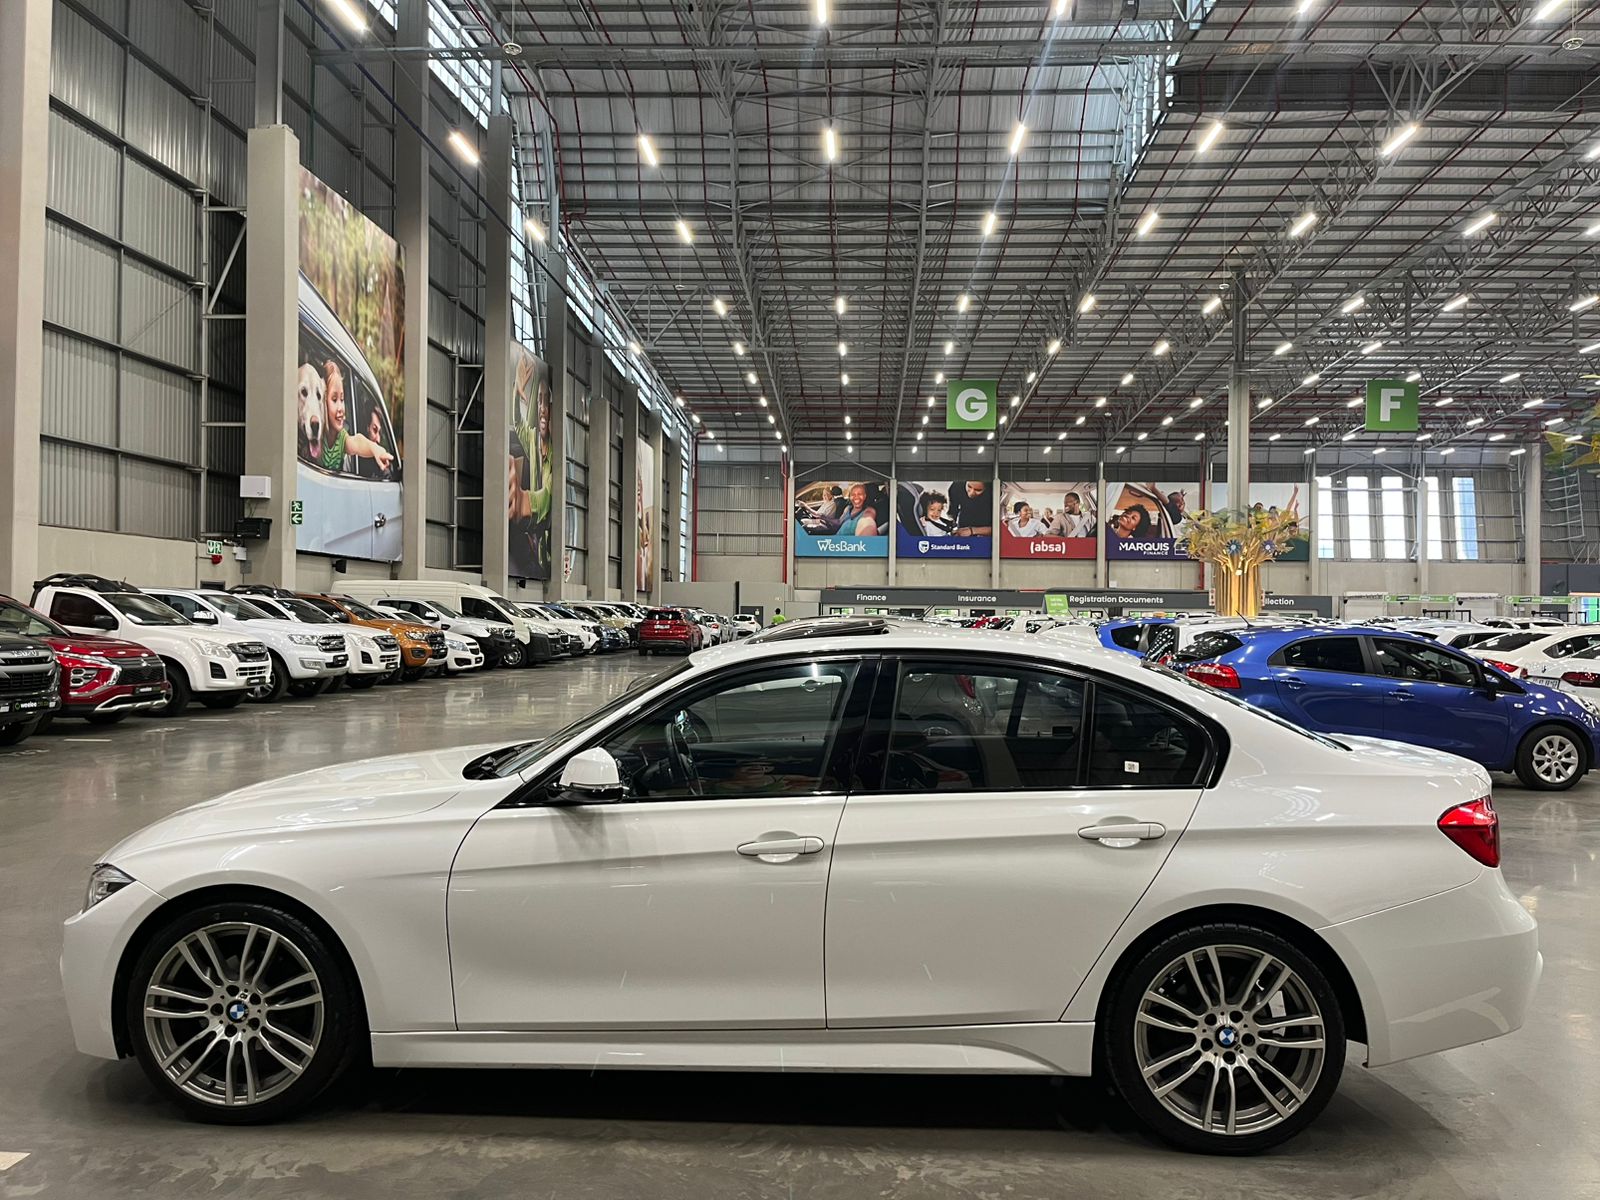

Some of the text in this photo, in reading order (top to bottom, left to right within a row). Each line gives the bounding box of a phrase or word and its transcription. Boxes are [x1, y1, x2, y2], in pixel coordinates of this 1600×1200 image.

[956, 388, 988, 422] G
[1379, 388, 1405, 422] F
[817, 539, 867, 552] WesBank
[930, 543, 970, 551] Standard Bank
[1119, 542, 1170, 551] MARQUIS
[856, 593, 887, 601] Finance
[957, 594, 997, 602] Insurance
[1069, 595, 1117, 605] Registration
[1118, 596, 1164, 604] Documents
[1264, 597, 1295, 605] llection
